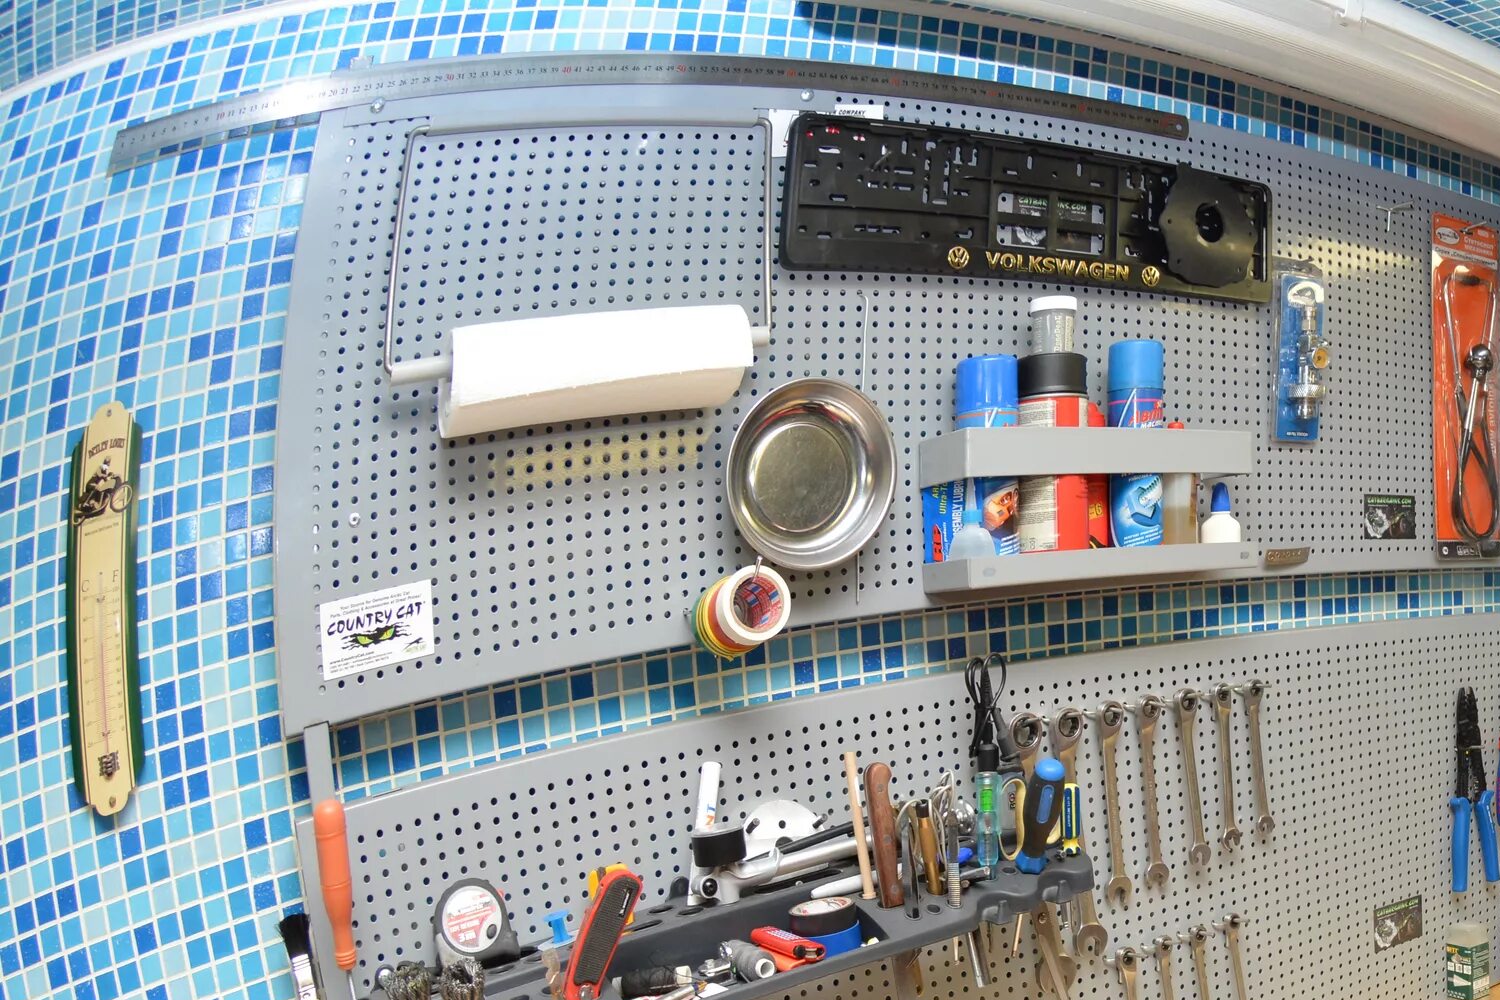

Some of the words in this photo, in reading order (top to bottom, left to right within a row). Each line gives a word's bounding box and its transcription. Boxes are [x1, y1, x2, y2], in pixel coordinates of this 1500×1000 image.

[986, 250, 1130, 282] VOLKSWAGEN
[82, 580, 90, 592] C
[112, 570, 119, 582] F
[326, 608, 392, 636] COUNTRY
[396, 602, 422, 619] CAT
